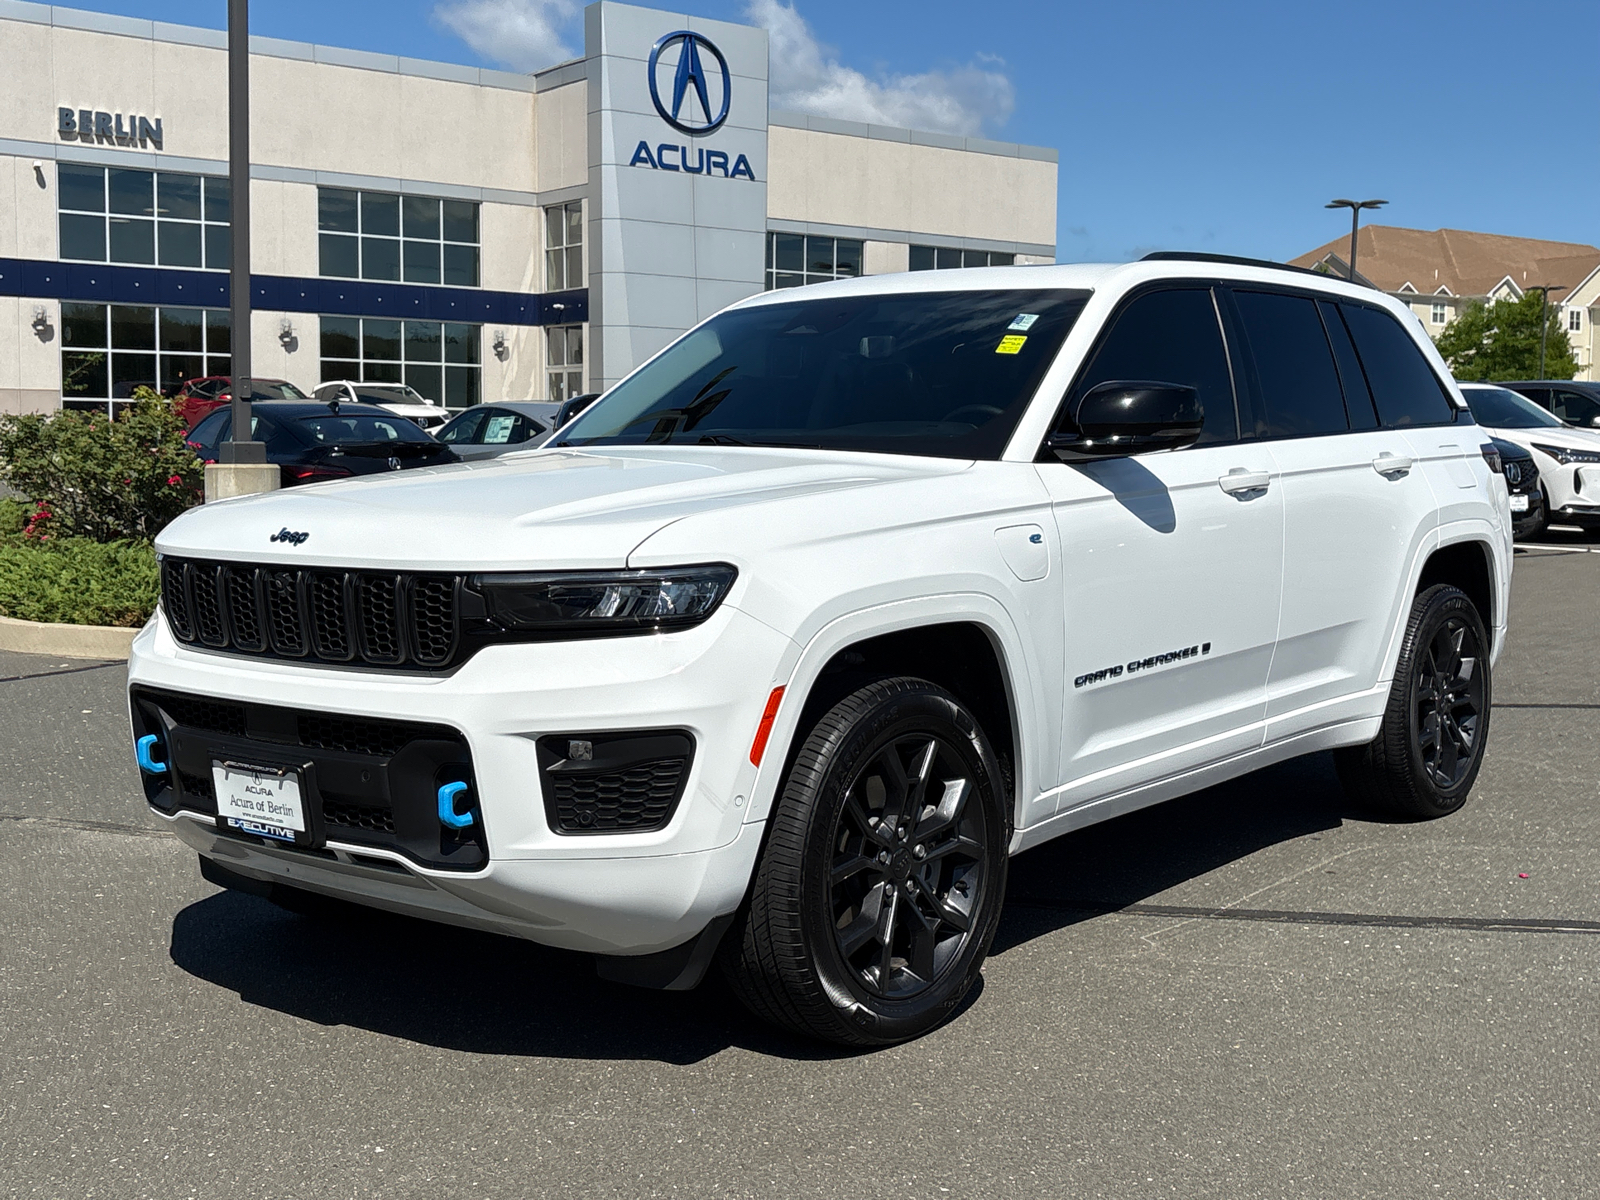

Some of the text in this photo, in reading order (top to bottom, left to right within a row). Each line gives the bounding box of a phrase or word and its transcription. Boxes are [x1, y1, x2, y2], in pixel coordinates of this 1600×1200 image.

[58, 107, 163, 144] BERLIN
[629, 141, 756, 181] ACURA
[270, 527, 310, 547] Jeep
[1074, 645, 1200, 688] GRAND CHEROKEE
[245, 785, 273, 797] ACURA
[230, 794, 294, 817] Acura of Berlin
[227, 818, 295, 838] EXECUTIVE
